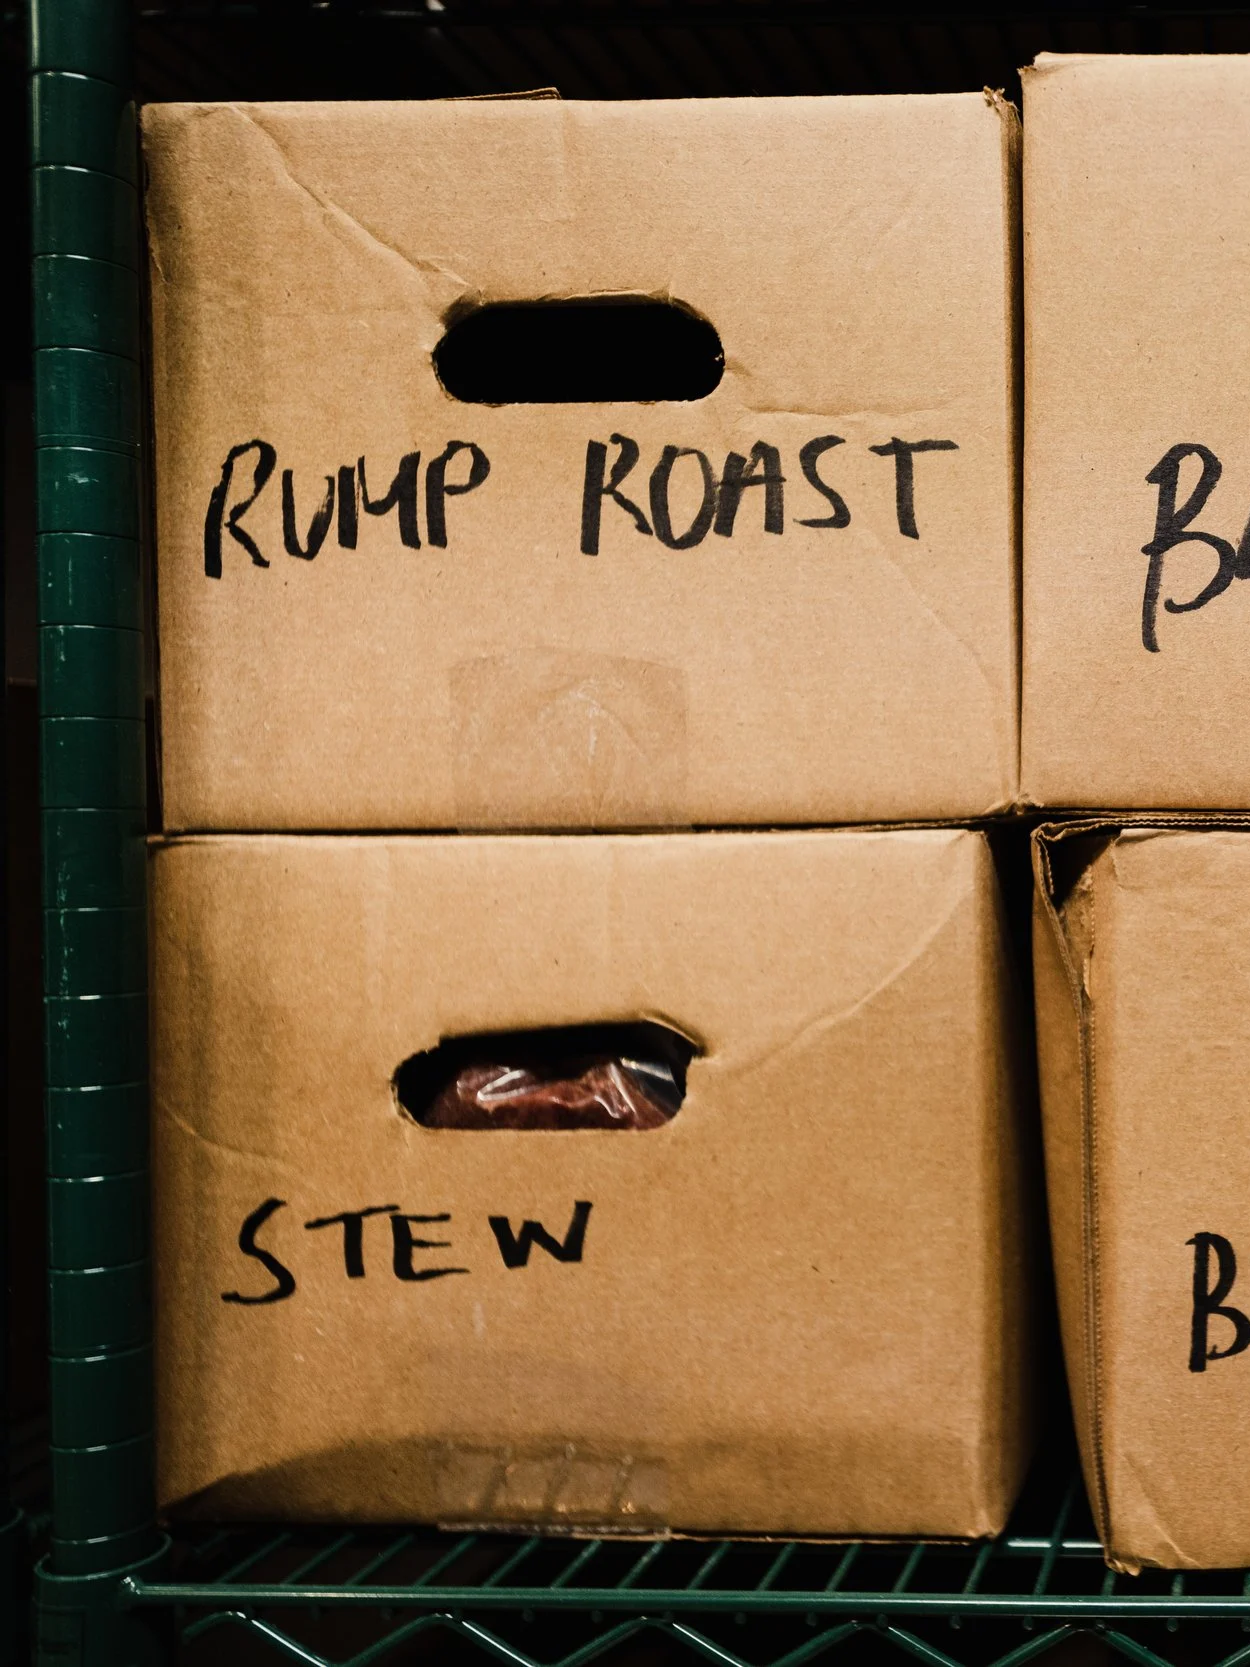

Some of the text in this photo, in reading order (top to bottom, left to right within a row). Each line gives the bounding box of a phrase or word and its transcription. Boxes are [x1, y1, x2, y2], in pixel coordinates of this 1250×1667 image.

[204, 433, 957, 580] RUMP ROAST
[220, 1198, 593, 1306] STEW
